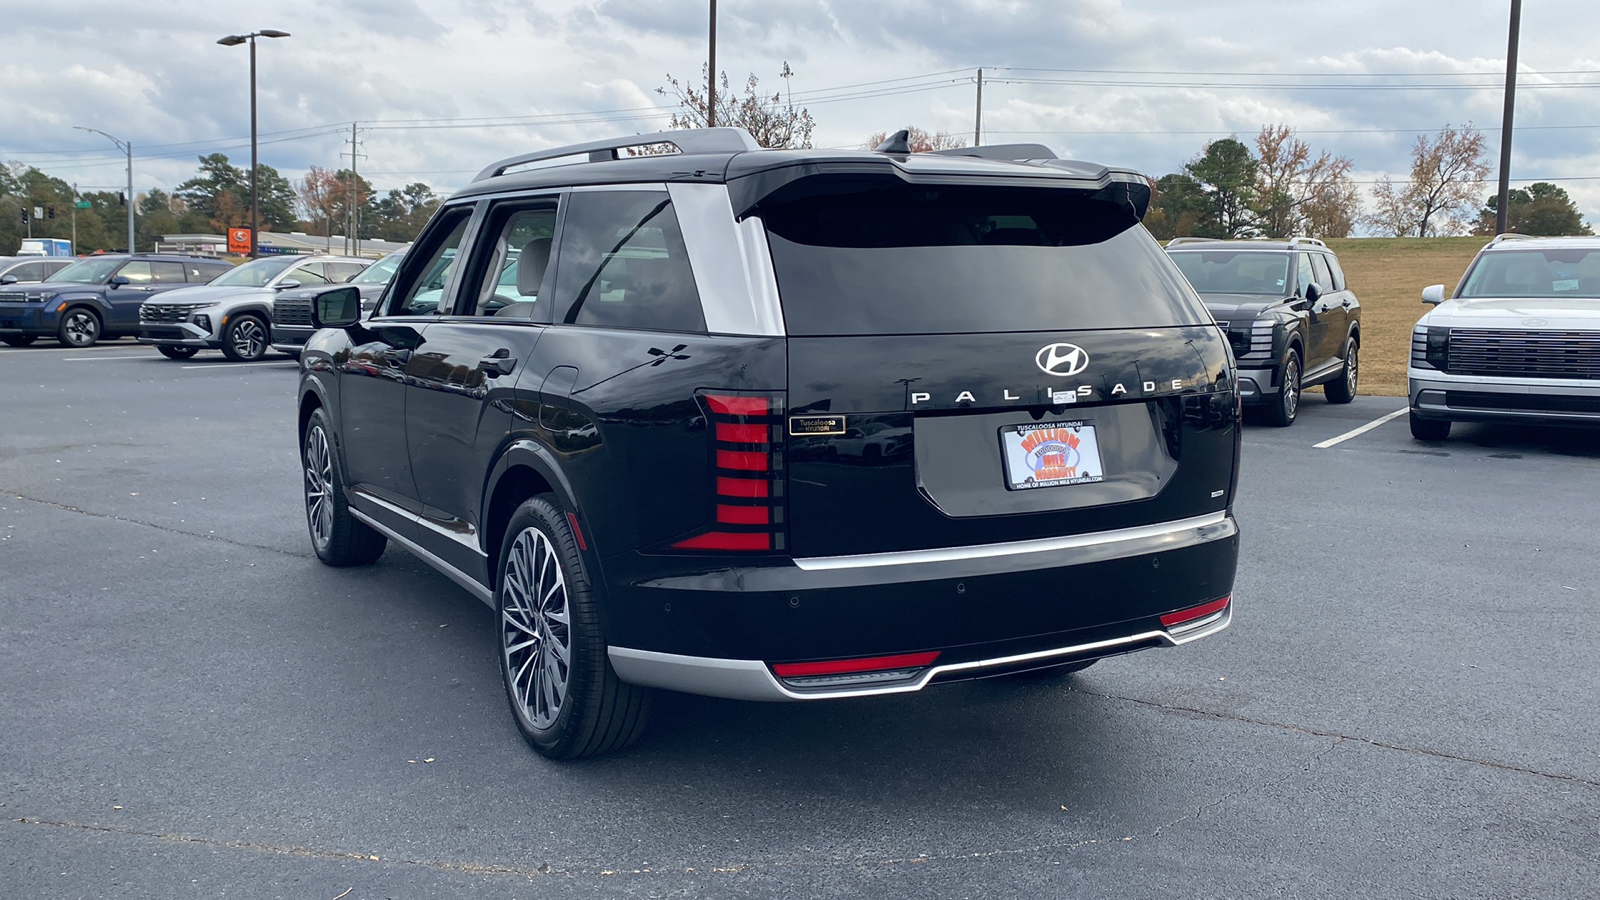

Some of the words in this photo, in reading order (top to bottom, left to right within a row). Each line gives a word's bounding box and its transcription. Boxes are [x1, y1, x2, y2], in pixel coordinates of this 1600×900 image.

[911, 379, 1182, 404] PALISADE
[1017, 422, 1055, 431] TUSCALOOSA
[1020, 428, 1081, 454] MILLION
[1042, 453, 1066, 468] MILE
[1034, 466, 1077, 480] WARRANTY
